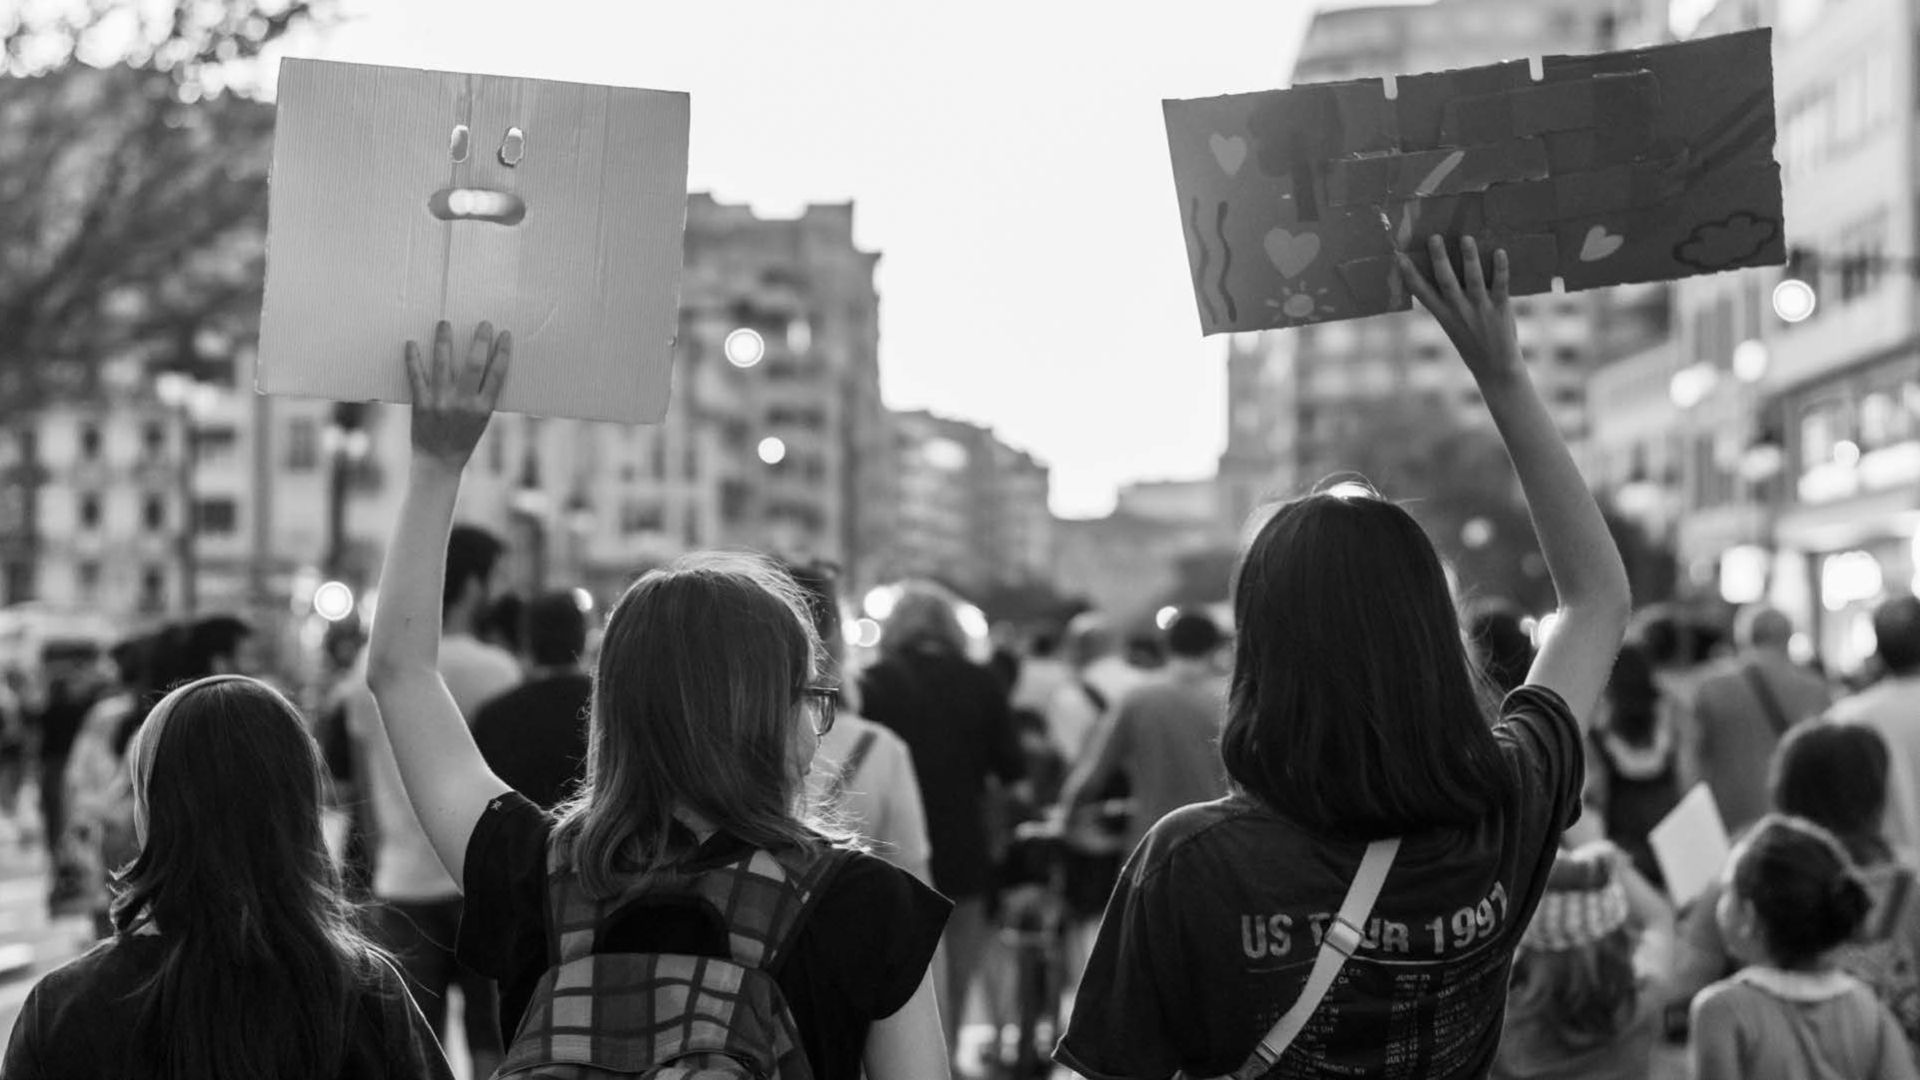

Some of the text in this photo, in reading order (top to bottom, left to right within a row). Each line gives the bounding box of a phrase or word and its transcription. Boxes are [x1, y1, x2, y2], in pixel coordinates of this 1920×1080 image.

[1240, 880, 1508, 959] US TUR 1997
